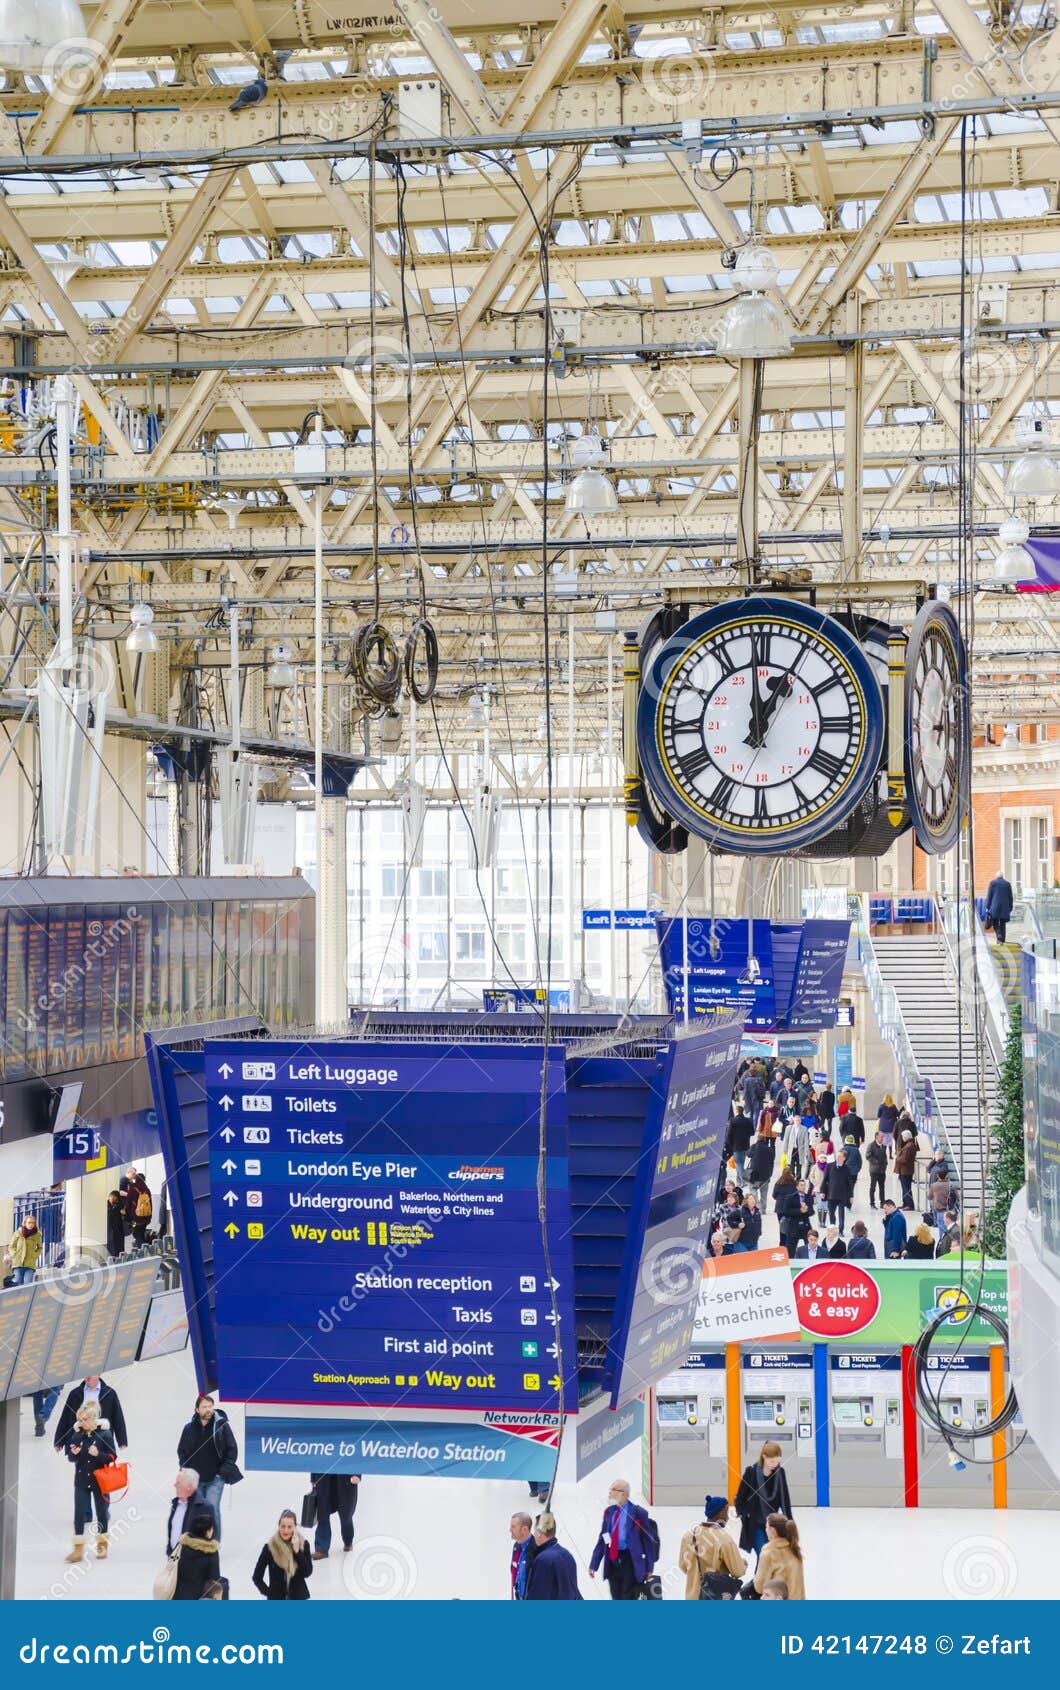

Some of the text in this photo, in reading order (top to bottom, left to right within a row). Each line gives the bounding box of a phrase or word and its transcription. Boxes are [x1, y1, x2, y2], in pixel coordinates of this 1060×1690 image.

[732, 676, 746, 686] 23
[714, 697, 728, 706] 22
[798, 695, 810, 704] 14
[707, 722, 720, 730] 21
[804, 720, 817, 730] 15
[713, 745, 727, 754] 20
[797, 747, 810, 756] 16
[731, 763, 744, 773] 19
[781, 765, 793, 775] 17
[755, 773, 768, 783] 18
[289, 1064, 398, 1085] Left Luggage
[285, 1096, 337, 1113] Toilets
[65, 1132, 89, 1155] 15
[286, 1128, 344, 1145] Tickets
[288, 1160, 417, 1180] London Eye Pier
[448, 1170, 505, 1181] clippers
[289, 1192, 393, 1212] Underground
[399, 1191, 504, 1203] Bakerloo, Northern and
[400, 1204, 495, 1218] Waterloo & City lines
[290, 1224, 361, 1244] Way out
[355, 1272, 492, 1294] Station reception
[696, 1283, 773, 1308] lf-service
[799, 1283, 869, 1302] It's quick
[452, 1306, 493, 1323] Taxis
[715, 1303, 793, 1327] machines
[808, 1302, 860, 1322] & easy
[383, 1336, 494, 1358] First aid point
[313, 1370, 496, 1391] Station Approach Way out
[483, 1410, 568, 1426] NetworkRal
[260, 1436, 506, 1462] Welcome to Waterloo Station
